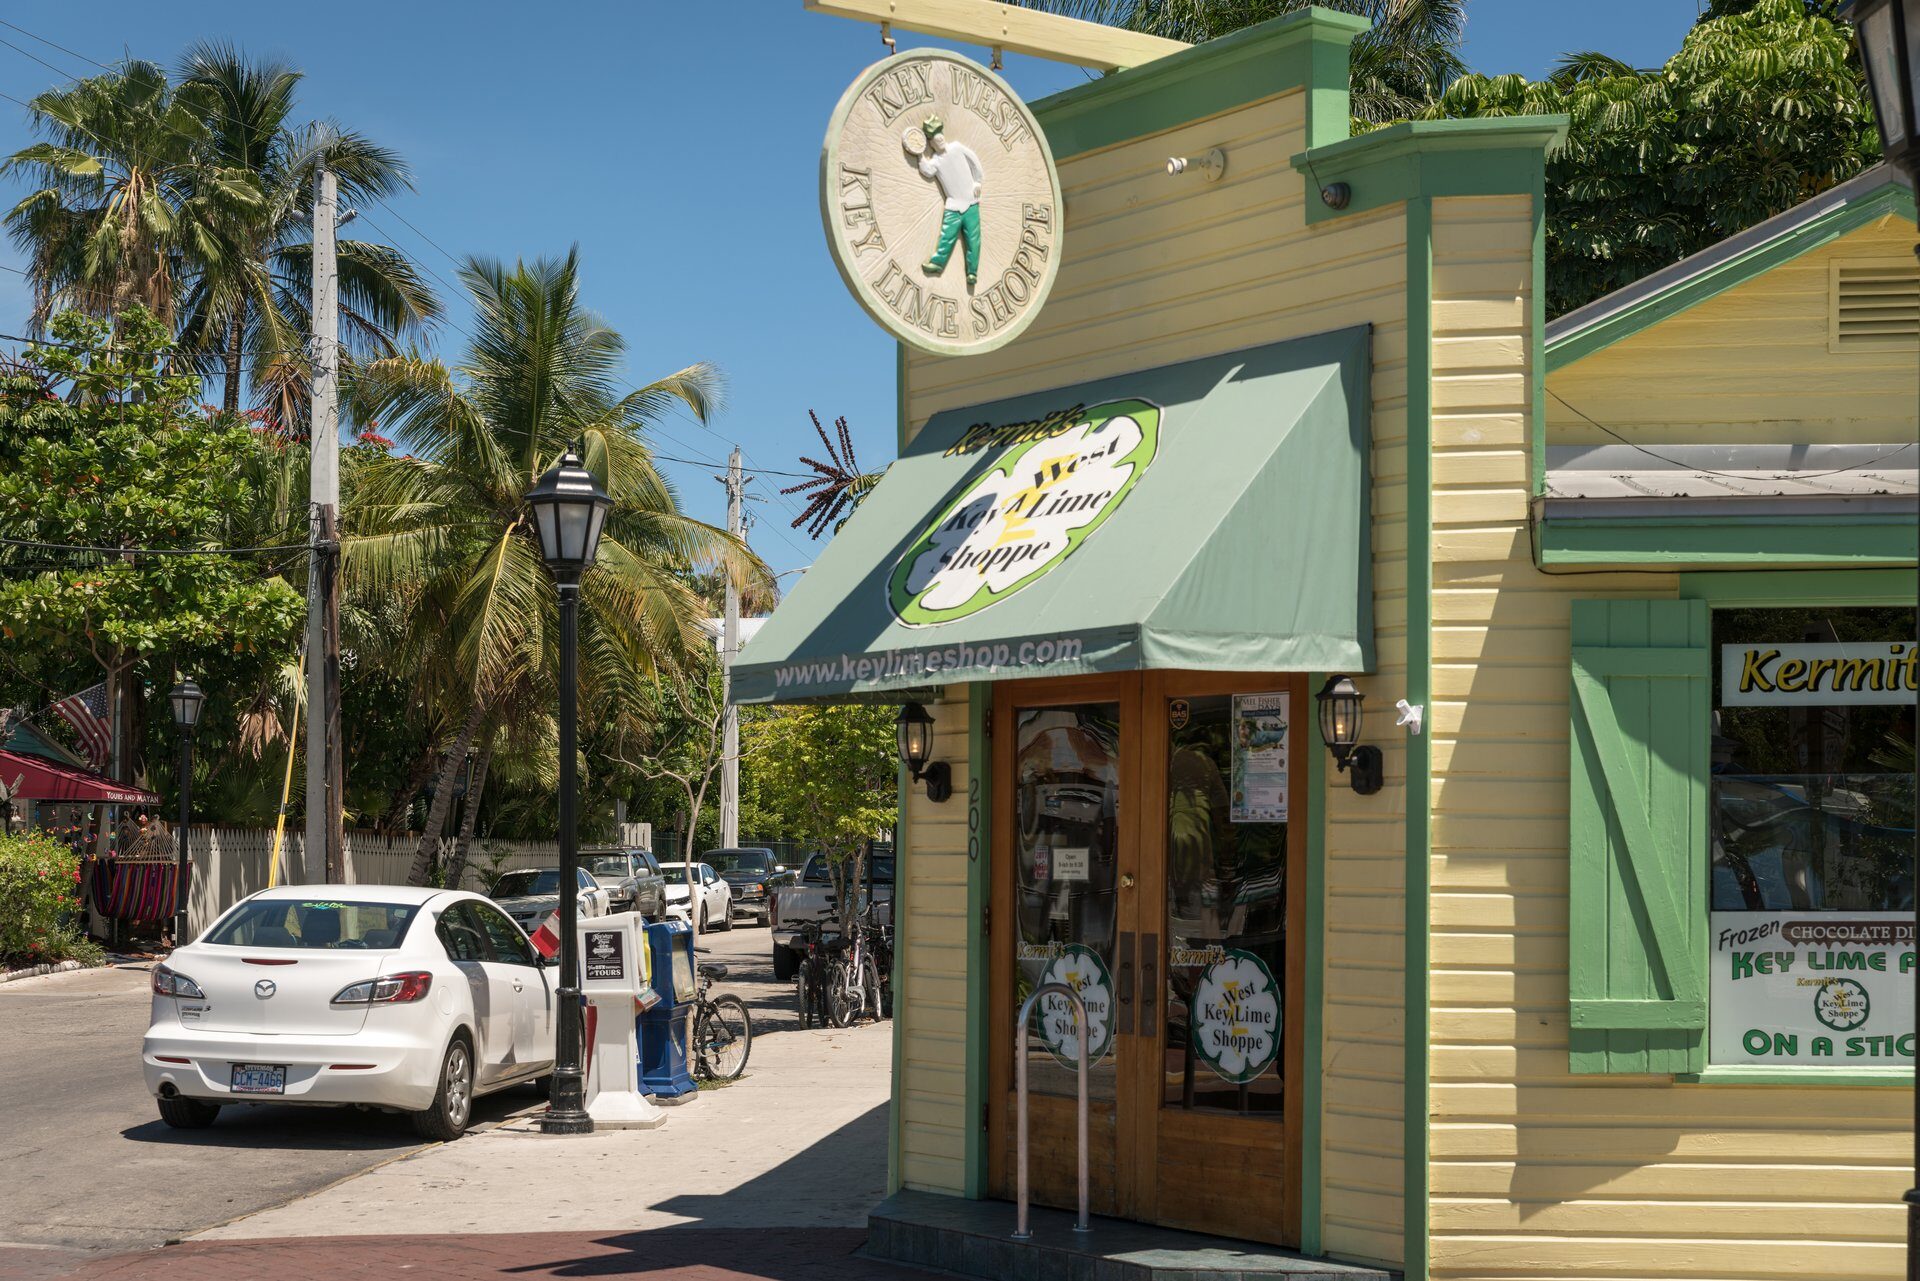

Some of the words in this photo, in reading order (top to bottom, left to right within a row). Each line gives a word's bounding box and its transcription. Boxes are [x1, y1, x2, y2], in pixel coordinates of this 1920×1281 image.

[865, 62, 933, 128] KEY
[949, 64, 1031, 151] WEST
[839, 162, 887, 257] KEY
[873, 259, 959, 338] LIME
[969, 203, 1051, 338] SHOPPE
[1034, 434, 1120, 489] West
[944, 502, 1004, 535] Key
[1025, 490, 1112, 518] Lime
[931, 540, 1050, 574] Shoppe
[775, 638, 1082, 687] www.keylimeshop.com
[1739, 644, 1917, 693] Kermit
[969, 778, 980, 863] 200
[1719, 920, 1780, 951] Frozen
[1790, 926, 1890, 939] CHOCOLATE
[1170, 945, 1226, 966] Kermit's
[1732, 952, 1795, 980] KEY
[1808, 951, 1886, 971] LIME
[1048, 995, 1070, 1015] Key
[1222, 981, 1256, 1006] West
[1822, 1000, 1839, 1009] Key
[1841, 999, 1864, 1008] Lime
[1833, 989, 1854, 1001] West
[1205, 1003, 1231, 1026] Key
[1236, 1005, 1271, 1024] Lime
[1828, 1010, 1859, 1019] Shoppe
[1213, 1029, 1263, 1053] Shoppe
[1742, 1029, 1798, 1056] ON
[1811, 1037, 1833, 1056] A
[233, 1071, 283, 1088] CCM-4466
